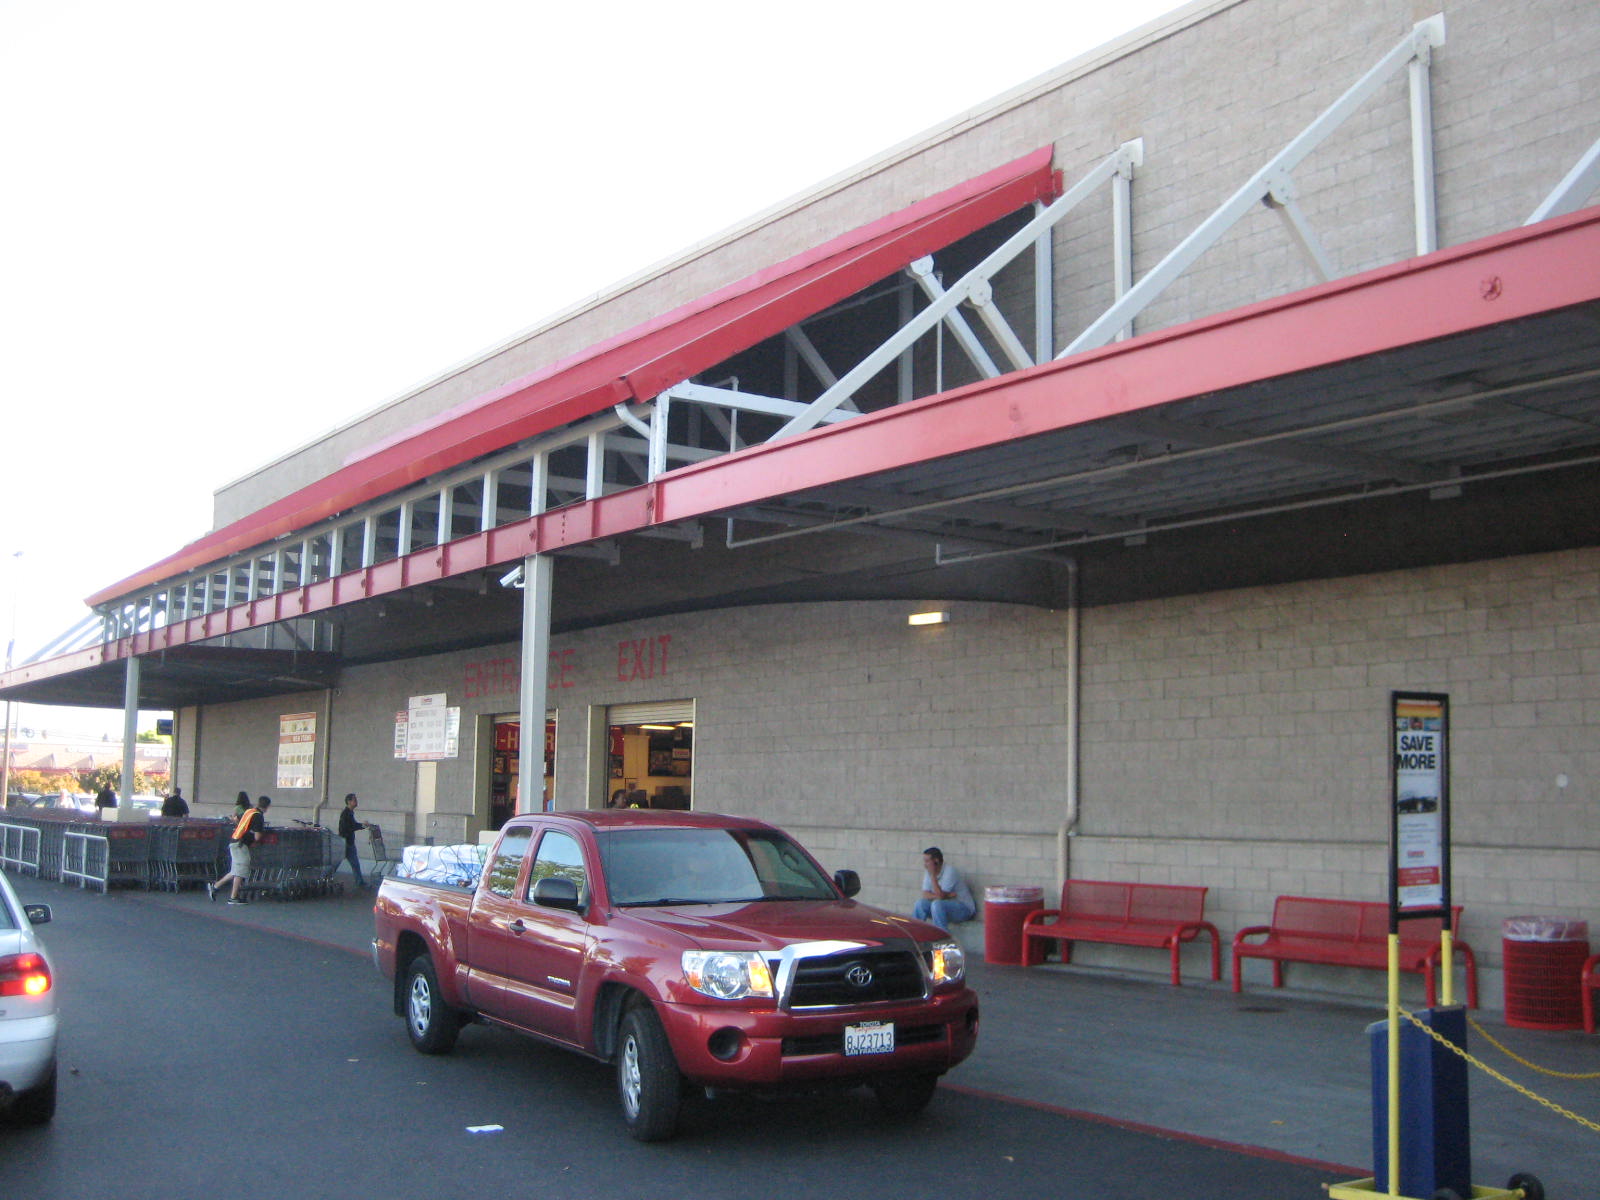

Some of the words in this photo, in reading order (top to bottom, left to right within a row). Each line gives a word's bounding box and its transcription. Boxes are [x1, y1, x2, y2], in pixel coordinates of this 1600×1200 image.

[463, 649, 576, 698] ENTRCE
[617, 634, 672, 682] EXIT
[1401, 735, 1433, 751] SAVE
[1397, 753, 1436, 769] MORE
